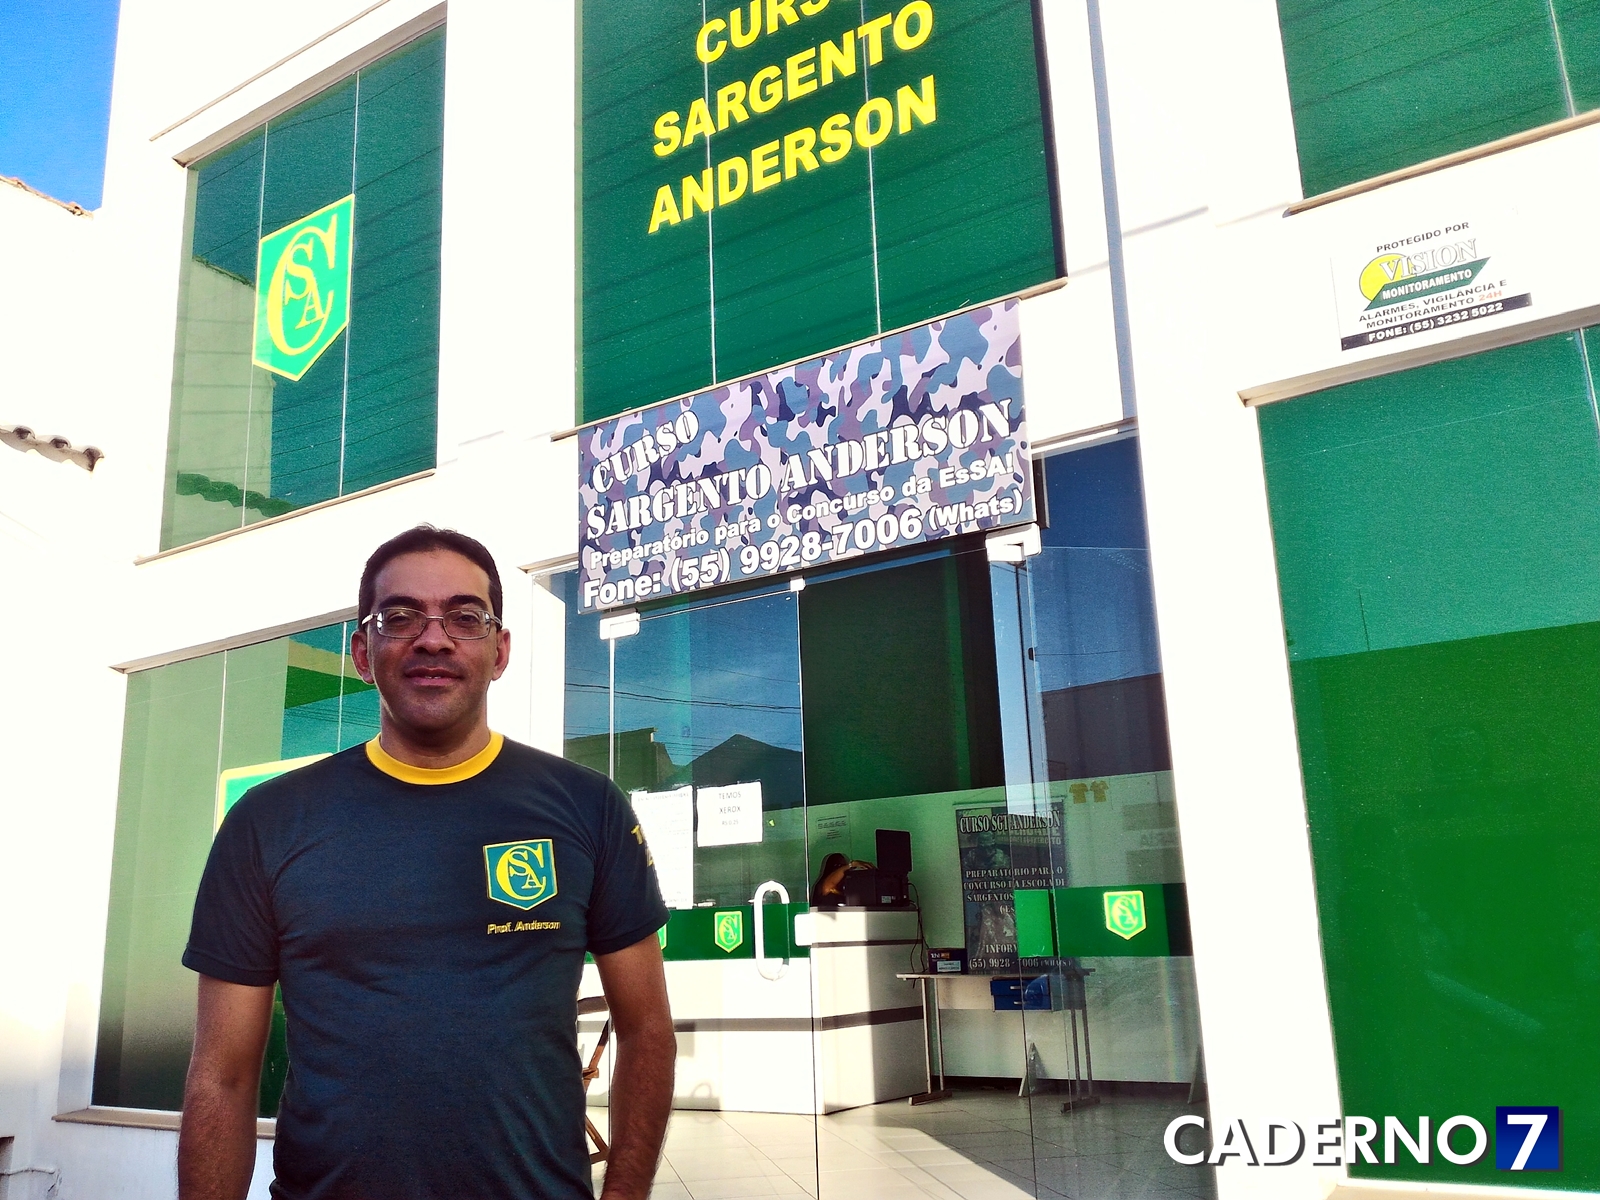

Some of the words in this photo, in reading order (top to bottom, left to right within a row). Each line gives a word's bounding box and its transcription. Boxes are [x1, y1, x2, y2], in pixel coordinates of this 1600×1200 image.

[696, 0, 831, 63] CUR
[653, 0, 934, 157] SARGENTO
[648, 74, 937, 234] ANDERSON
[1376, 229, 1441, 252] PROTEGIDO
[1445, 221, 1470, 234] POR
[1379, 238, 1478, 281] VISION
[1359, 302, 1420, 322] ALARMES,
[1500, 279, 1507, 287] E
[1382, 268, 1472, 300] MONITORAMENTO
[1366, 297, 1475, 329] MONITORAMENTO
[1478, 290, 1503, 302] 24H
[1368, 326, 1407, 342] FONE:
[1409, 319, 1435, 334] (55)
[1437, 310, 1470, 326] 3232
[1471, 302, 1504, 317] 5022
[587, 464, 772, 540] SARGENTO
[780, 398, 1012, 492] ANDERSON
[592, 410, 700, 493] CURSO
[591, 528, 709, 570] Preparatório
[715, 517, 761, 545] para
[767, 514, 781, 528] o
[787, 485, 895, 523] Concurso
[902, 475, 932, 497] da
[939, 452, 1014, 488] EsSA!
[584, 572, 661, 608] Fone:
[671, 548, 731, 593] (55)
[740, 508, 922, 575] 9928-7006
[929, 489, 1023, 531] (Whats)
[718, 791, 741, 800] TEMOS
[719, 805, 741, 814] XEROX
[960, 815, 990, 833] CURSO
[1011, 810, 1061, 830] ANDERSON
[963, 880, 1006, 890] CONCURSO
[1056, 866, 1063, 874] O
[487, 922, 513, 935] Prof.
[514, 920, 561, 932] Anderson
[969, 957, 986, 969] (55)
[988, 958, 1010, 968] 9928
